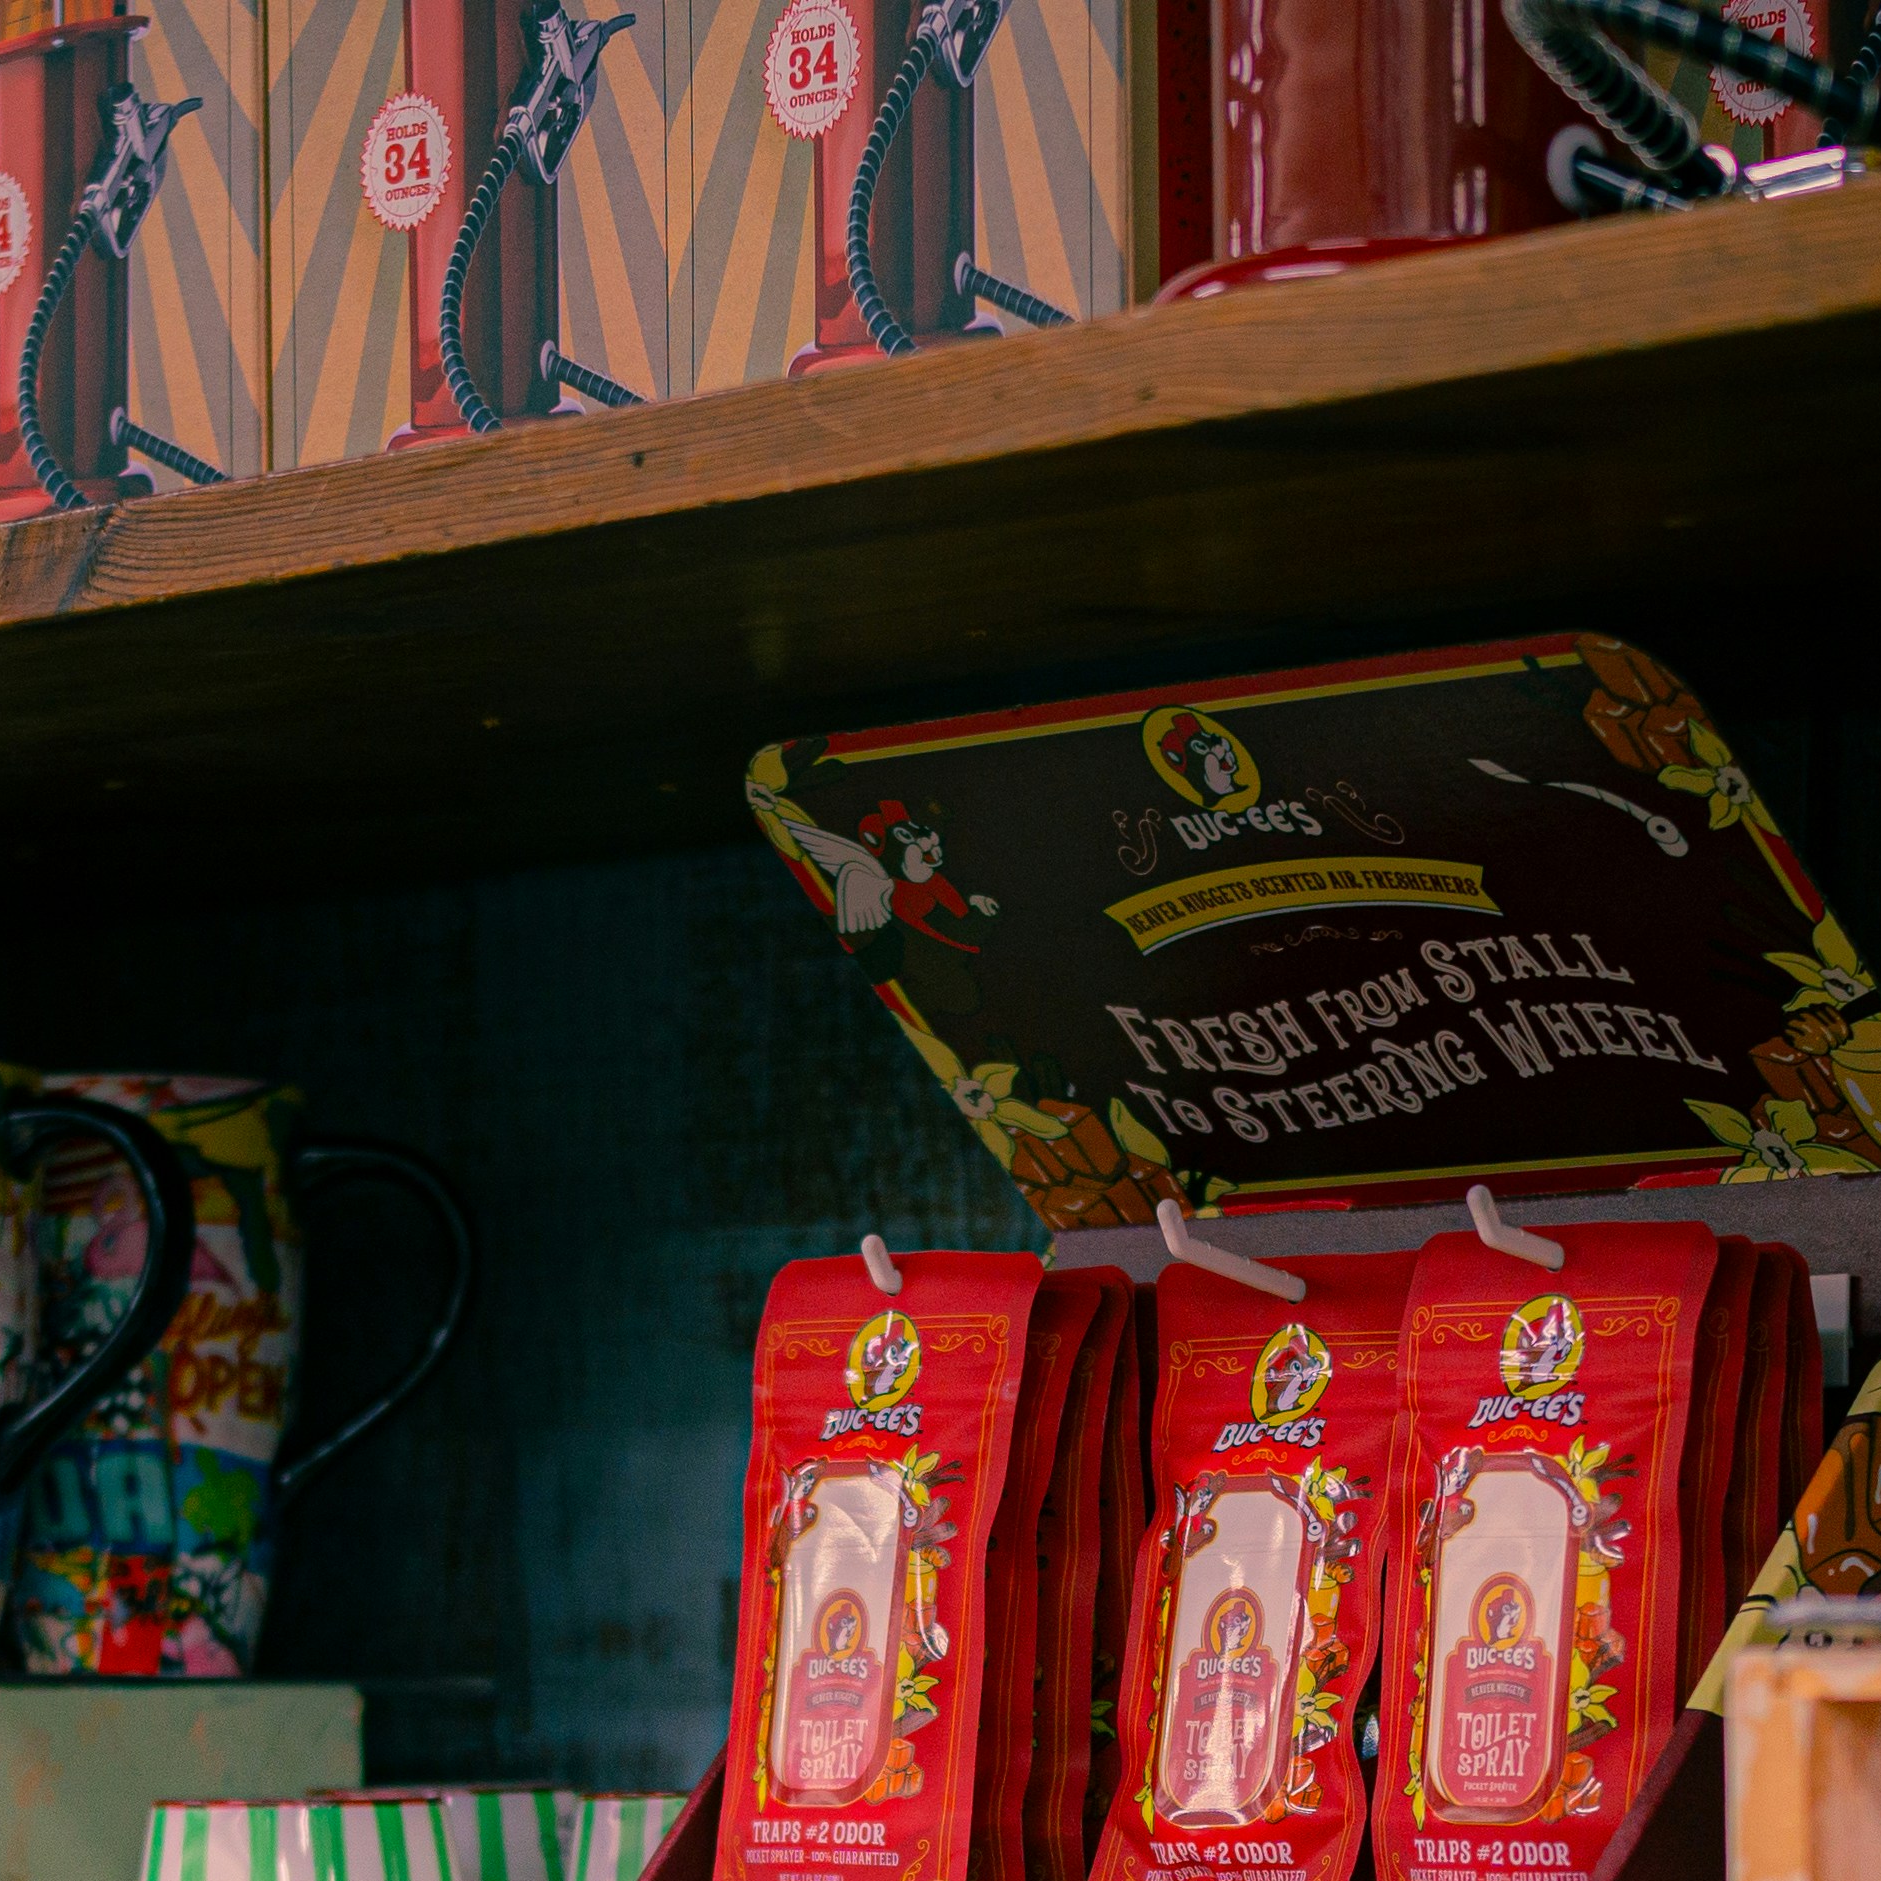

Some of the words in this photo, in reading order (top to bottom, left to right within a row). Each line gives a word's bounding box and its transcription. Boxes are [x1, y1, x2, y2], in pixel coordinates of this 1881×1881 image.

[791, 23, 835, 45] HOLDS
[1738, 9, 1786, 30] HOLDS
[789, 41, 837, 90] 34
[790, 88, 837, 108] OUNCES
[386, 121, 428, 141] HOLDS
[385, 138, 430, 184] 34
[385, 183, 430, 201] OUNCES
[1170, 800, 1322, 850] BUC-EE'S
[1125, 901, 1185, 935] BEAVER
[1178, 881, 1253, 914] NUGGETS
[1252, 871, 1327, 898] SCENTED
[1330, 870, 1362, 890] AIR
[1360, 870, 1480, 897] FRESHENERS
[1105, 1000, 1317, 1077] FRESH
[1308, 966, 1430, 1052] FROM
[1420, 932, 1635, 1004] STALL
[1126, 1080, 1214, 1138] TO
[1212, 1029, 1489, 1143] STEERING
[1469, 999, 1727, 1078] WHEEL
[170, 1345, 285, 1426] OPEN
[819, 1403, 924, 1441] BUC-EE'S
[1466, 1392, 1586, 1429] BUC-EE'S
[1211, 1417, 1327, 1453] BUC-EE'S
[808, 1658, 868, 1680] BUC-EE'S
[1466, 1647, 1535, 1670] BUC-EE'S
[1471, 1683, 1496, 1698] BEAVER
[1497, 1682, 1526, 1698] NUGGETS
[799, 1719, 868, 1756] TOILET
[1457, 1712, 1537, 1751] TOILET
[799, 1743, 863, 1780] SPRAY
[1457, 1738, 1531, 1777] SPRAY
[753, 1821, 801, 1843] TRAPS
[805, 1821, 829, 1844] #2
[832, 1822, 886, 1846] ODOR
[745, 1849, 770, 1864] POCKET
[770, 1849, 805, 1864] SPRAYER
[832, 1851, 899, 1867] GUARANTEED
[1150, 1842, 1201, 1865] TRAPS
[1203, 1842, 1232, 1865] #2
[1234, 1841, 1294, 1865] ODOR
[1414, 1839, 1471, 1864] TRAPS
[1476, 1841, 1504, 1866] #2
[1509, 1842, 1571, 1867] ODOR
